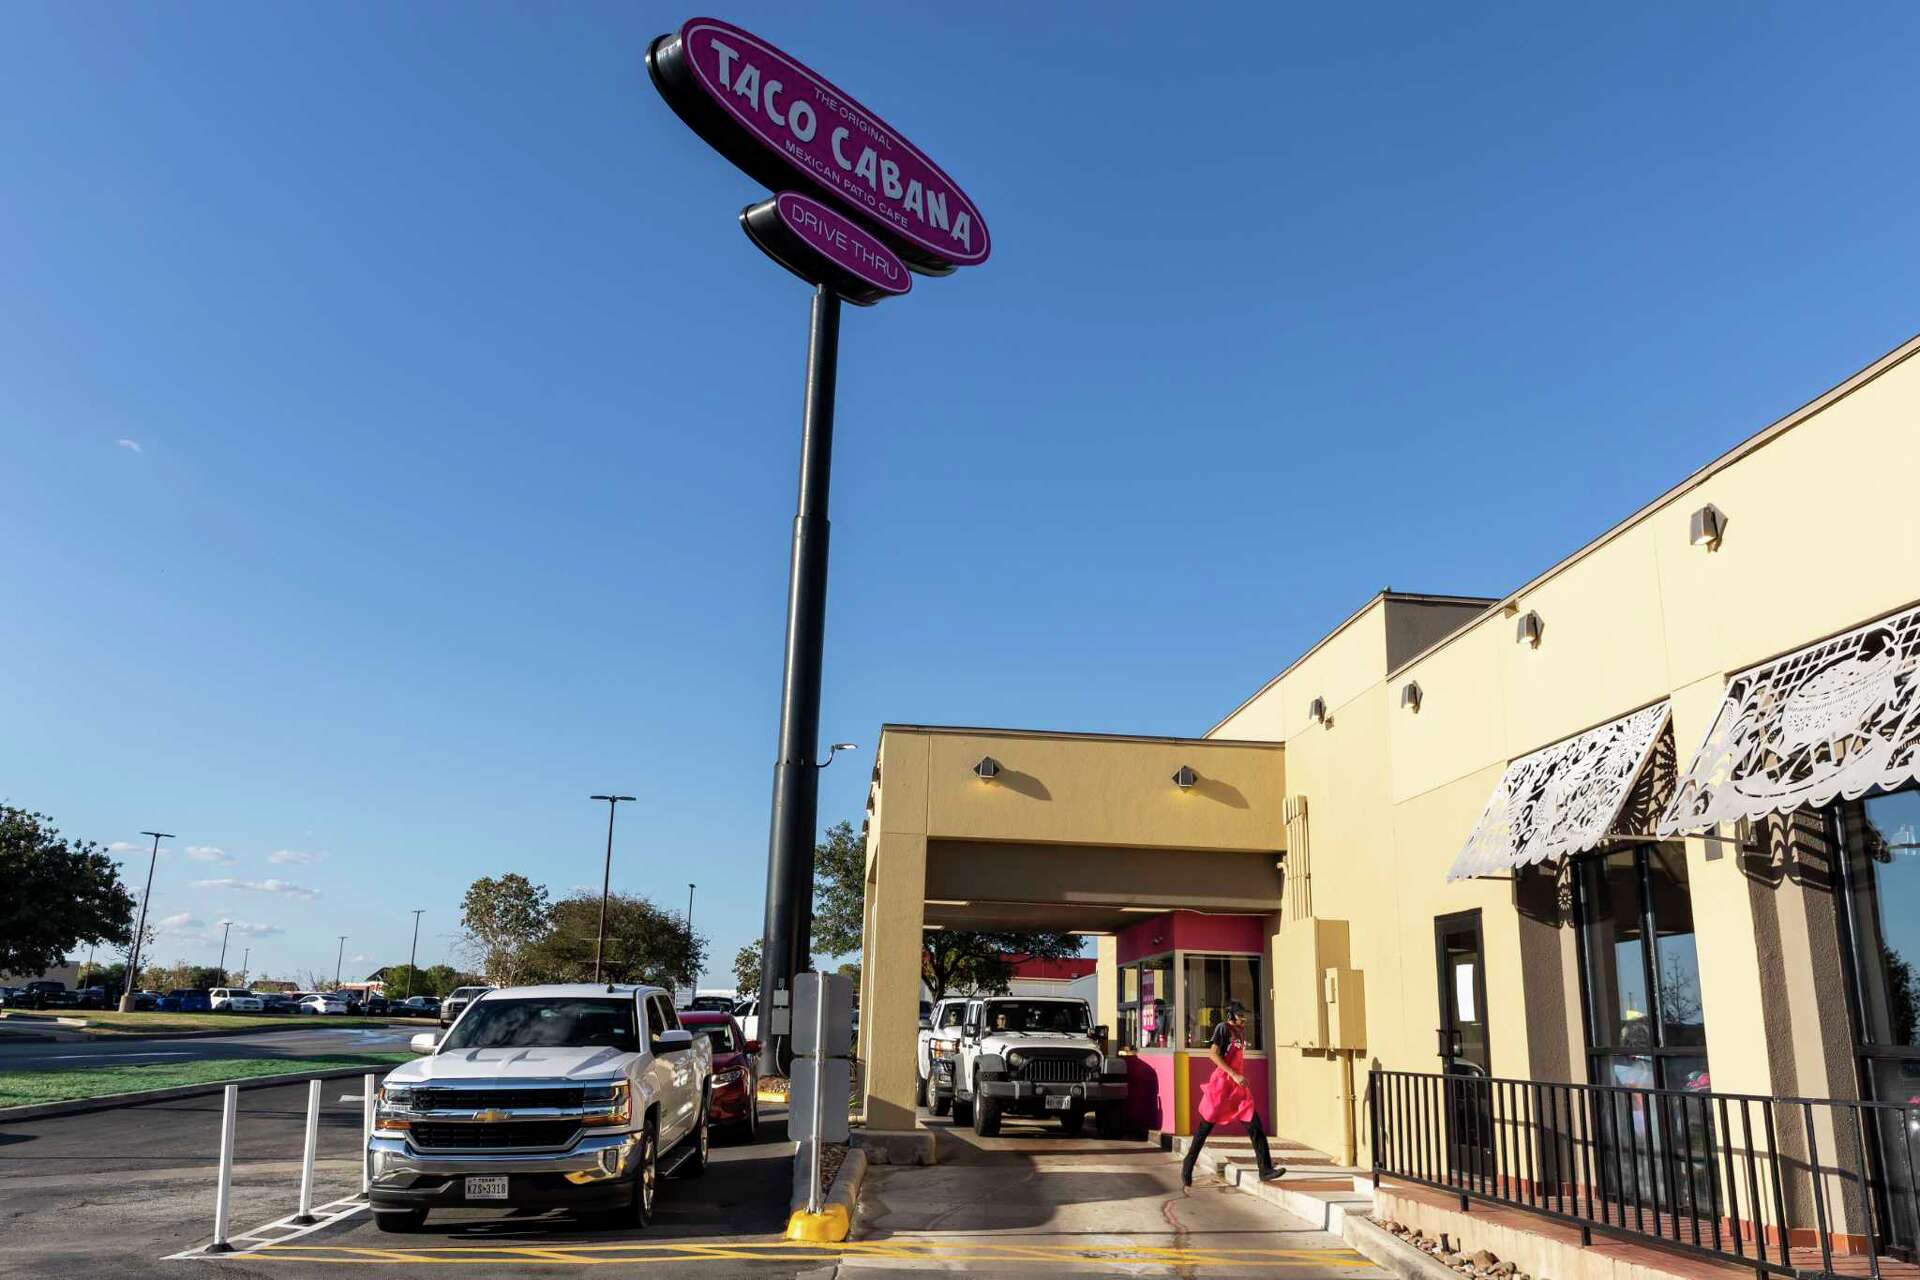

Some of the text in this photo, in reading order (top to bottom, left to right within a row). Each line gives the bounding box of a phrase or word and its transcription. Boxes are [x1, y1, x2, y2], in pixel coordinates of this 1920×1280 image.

[710, 38, 971, 253] TACO CABANA
[814, 86, 893, 150] THE ORIGINAL
[785, 139, 909, 228] MEXICAN PATIO CAFE
[791, 203, 899, 280] DRIVE THRU
